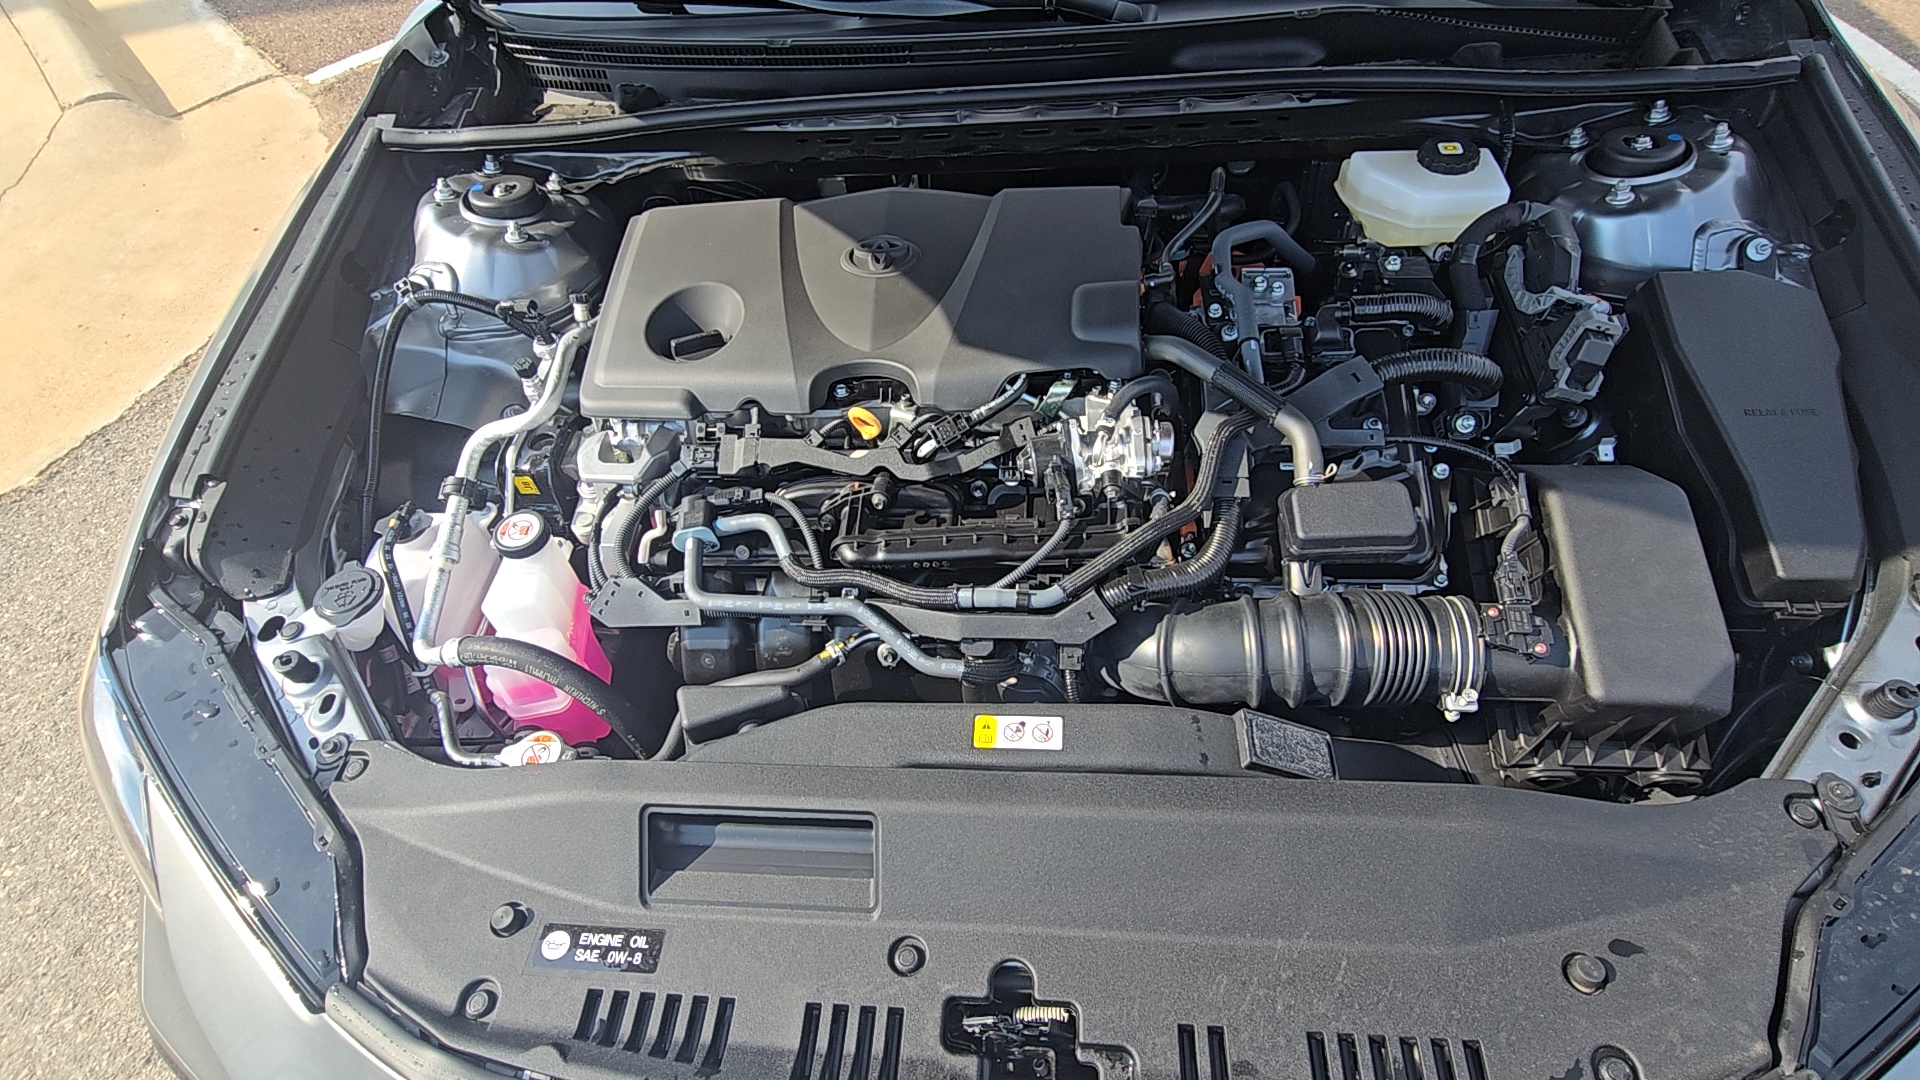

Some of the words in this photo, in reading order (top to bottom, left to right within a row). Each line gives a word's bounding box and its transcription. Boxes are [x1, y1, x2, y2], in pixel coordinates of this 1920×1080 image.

[1743, 408, 1777, 417] RELAY
[579, 933, 625, 947] ENGINE
[630, 935, 650, 948] OIL
[574, 948, 600, 963] SAE
[607, 951, 643, 965] 0W-8
